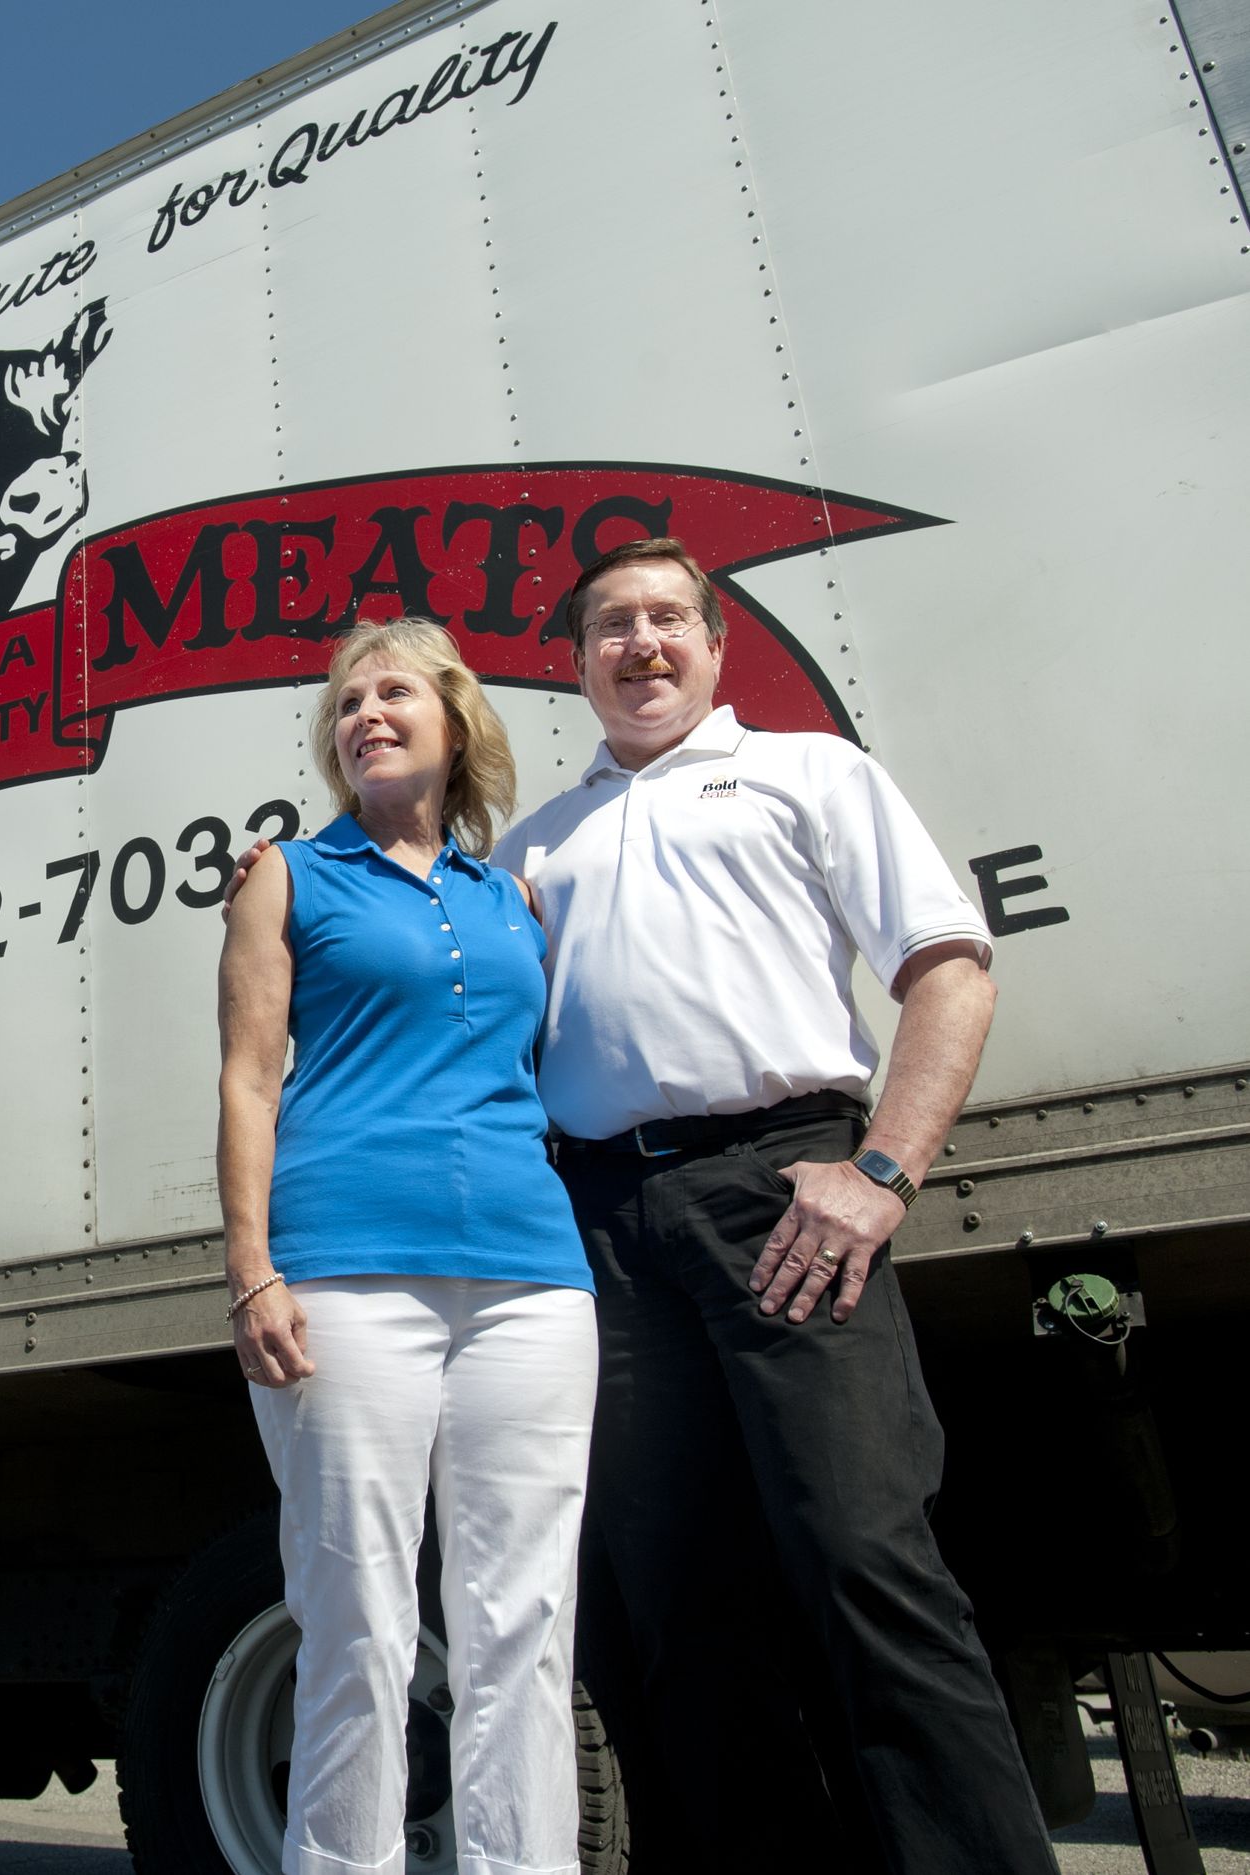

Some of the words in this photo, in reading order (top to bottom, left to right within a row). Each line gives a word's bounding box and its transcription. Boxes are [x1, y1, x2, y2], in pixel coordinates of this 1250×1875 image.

[146, 166, 259, 254] for
[267, 20, 558, 188] Quality
[91, 494, 674, 672] MEATS
[702, 779, 738, 792] Bold
